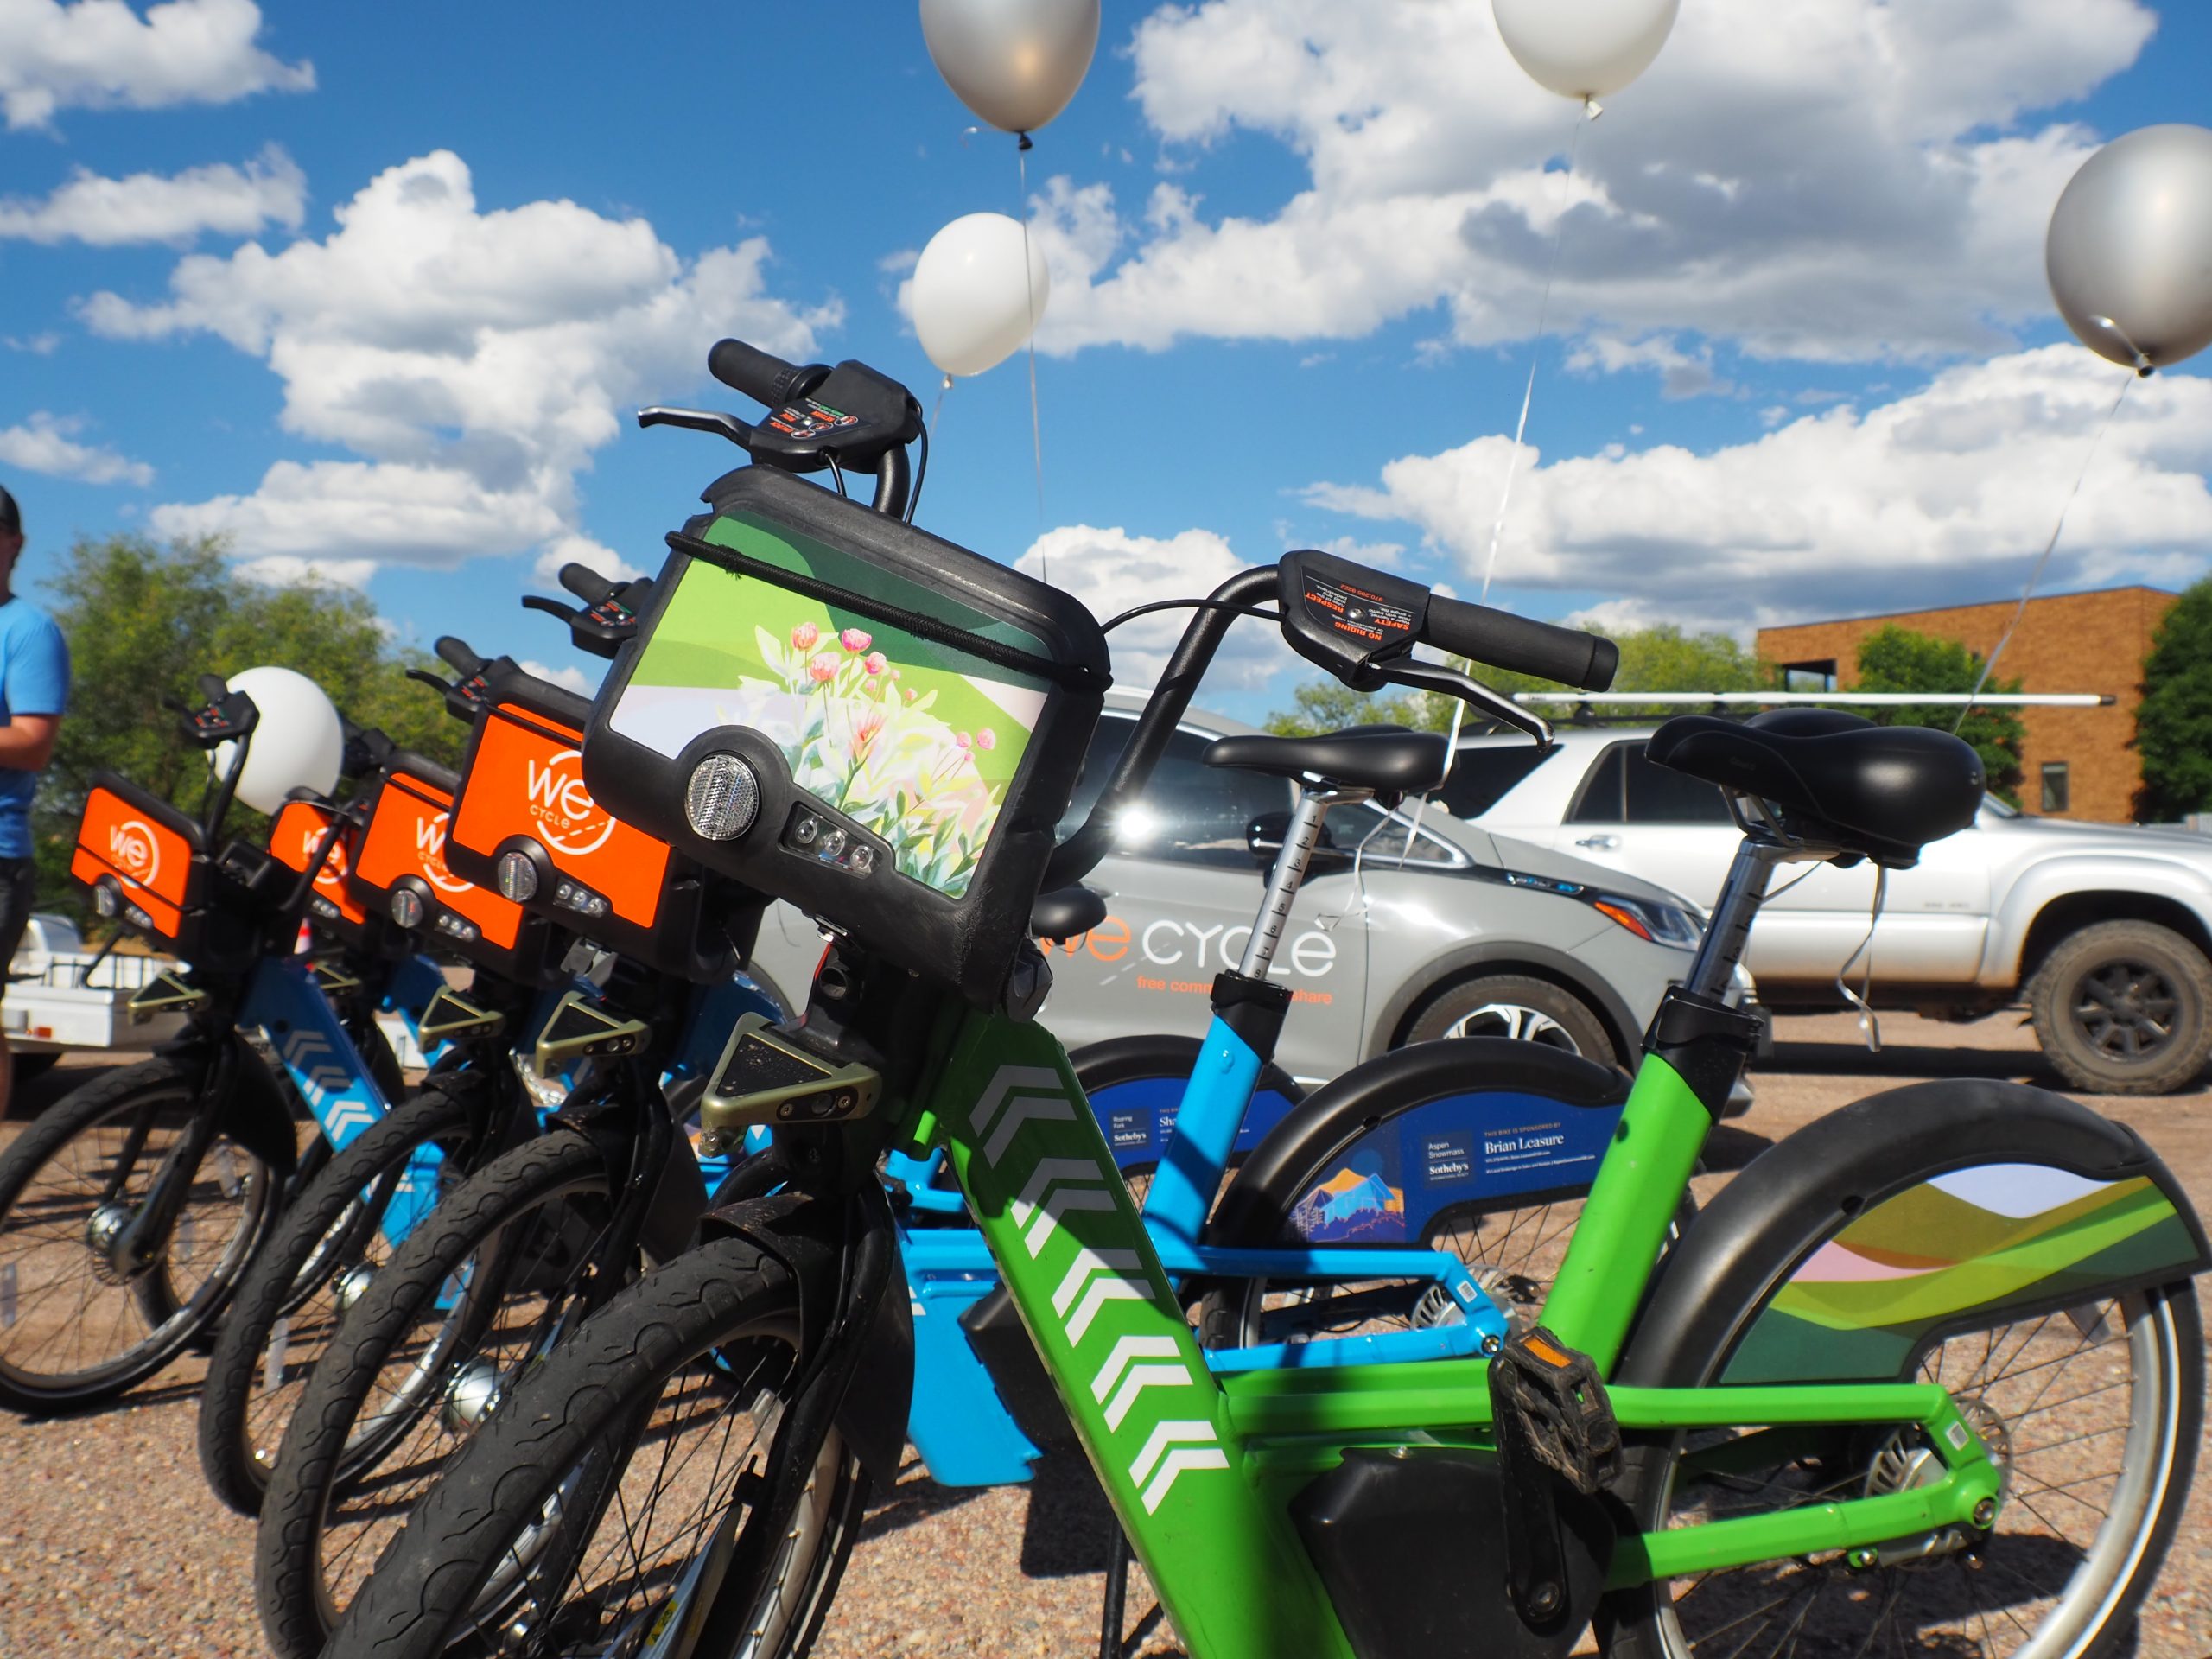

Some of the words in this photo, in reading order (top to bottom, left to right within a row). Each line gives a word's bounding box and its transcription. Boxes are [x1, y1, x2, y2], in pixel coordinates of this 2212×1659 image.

[1305, 593, 1344, 613] RESPECT
[1335, 622, 1366, 636] RIDING
[1375, 618, 1409, 630] SAFETY
[1301, 837, 1309, 846] 2
[1294, 859, 1301, 868] 3
[1278, 903, 1286, 912] 5
[1137, 976, 1166, 992] free
[1519, 1123, 1554, 1133] SPONSORED
[1428, 1142, 1450, 1151] Aspen
[1484, 1141, 1516, 1154] Brian
[1518, 1135, 1565, 1150] Leasure
[1428, 1149, 1465, 1159] Snowmass
[1429, 1162, 1469, 1175] Sotheby's
